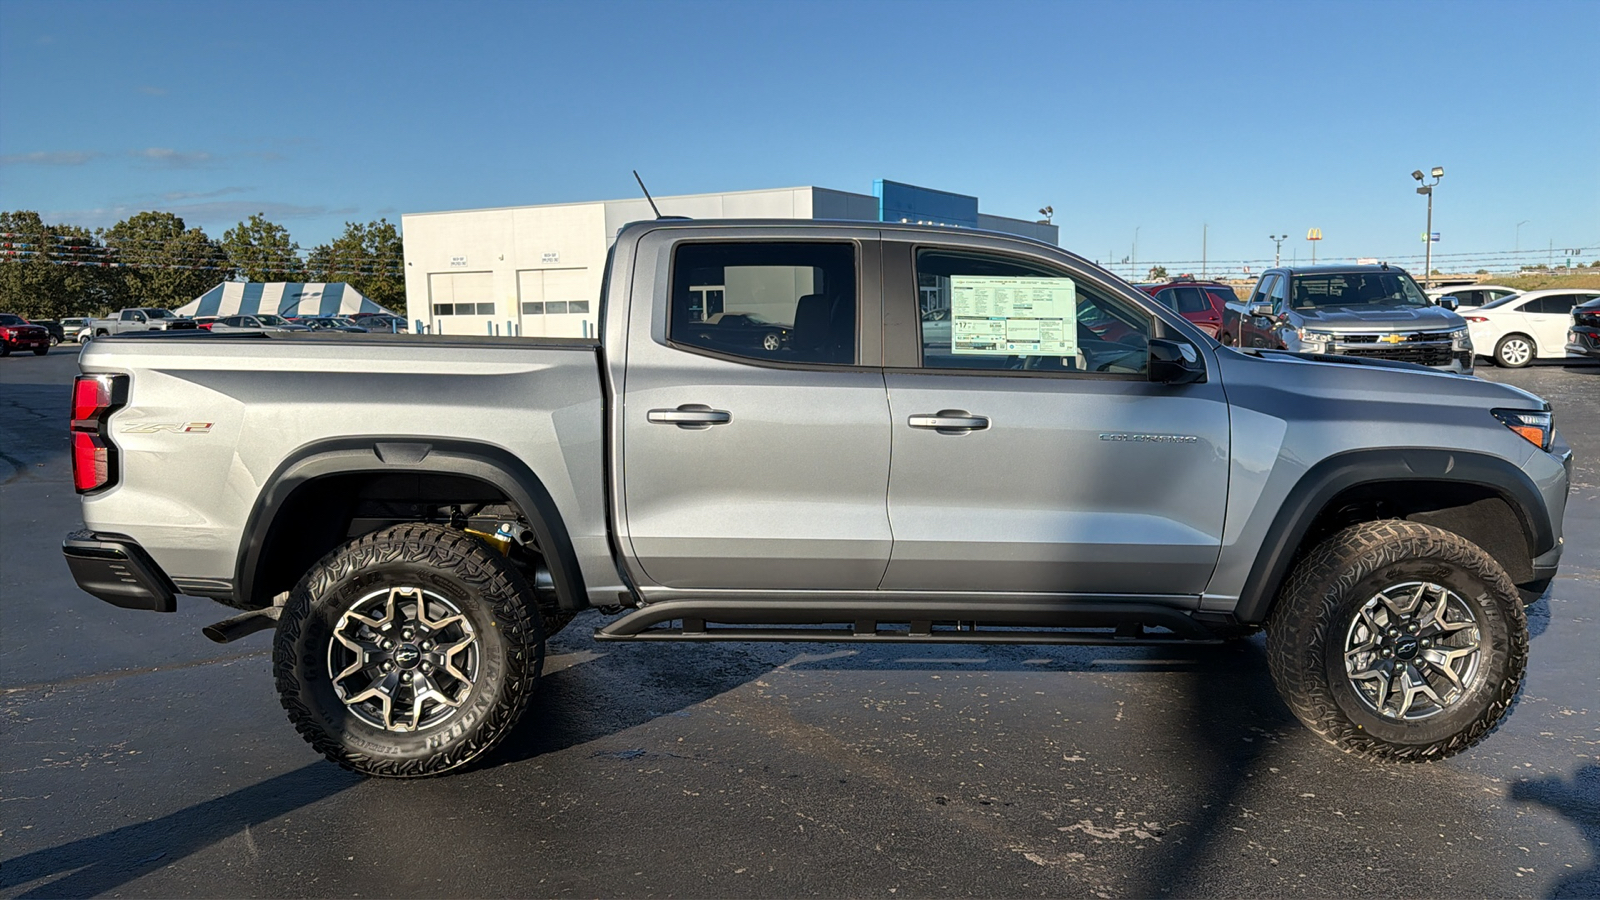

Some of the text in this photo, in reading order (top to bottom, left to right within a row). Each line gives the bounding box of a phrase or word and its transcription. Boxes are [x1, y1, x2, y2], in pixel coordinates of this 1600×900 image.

[120, 421, 215, 434] ZR2
[1099, 433, 1197, 444] COLORADO
[424, 645, 503, 749] WRANGLER
